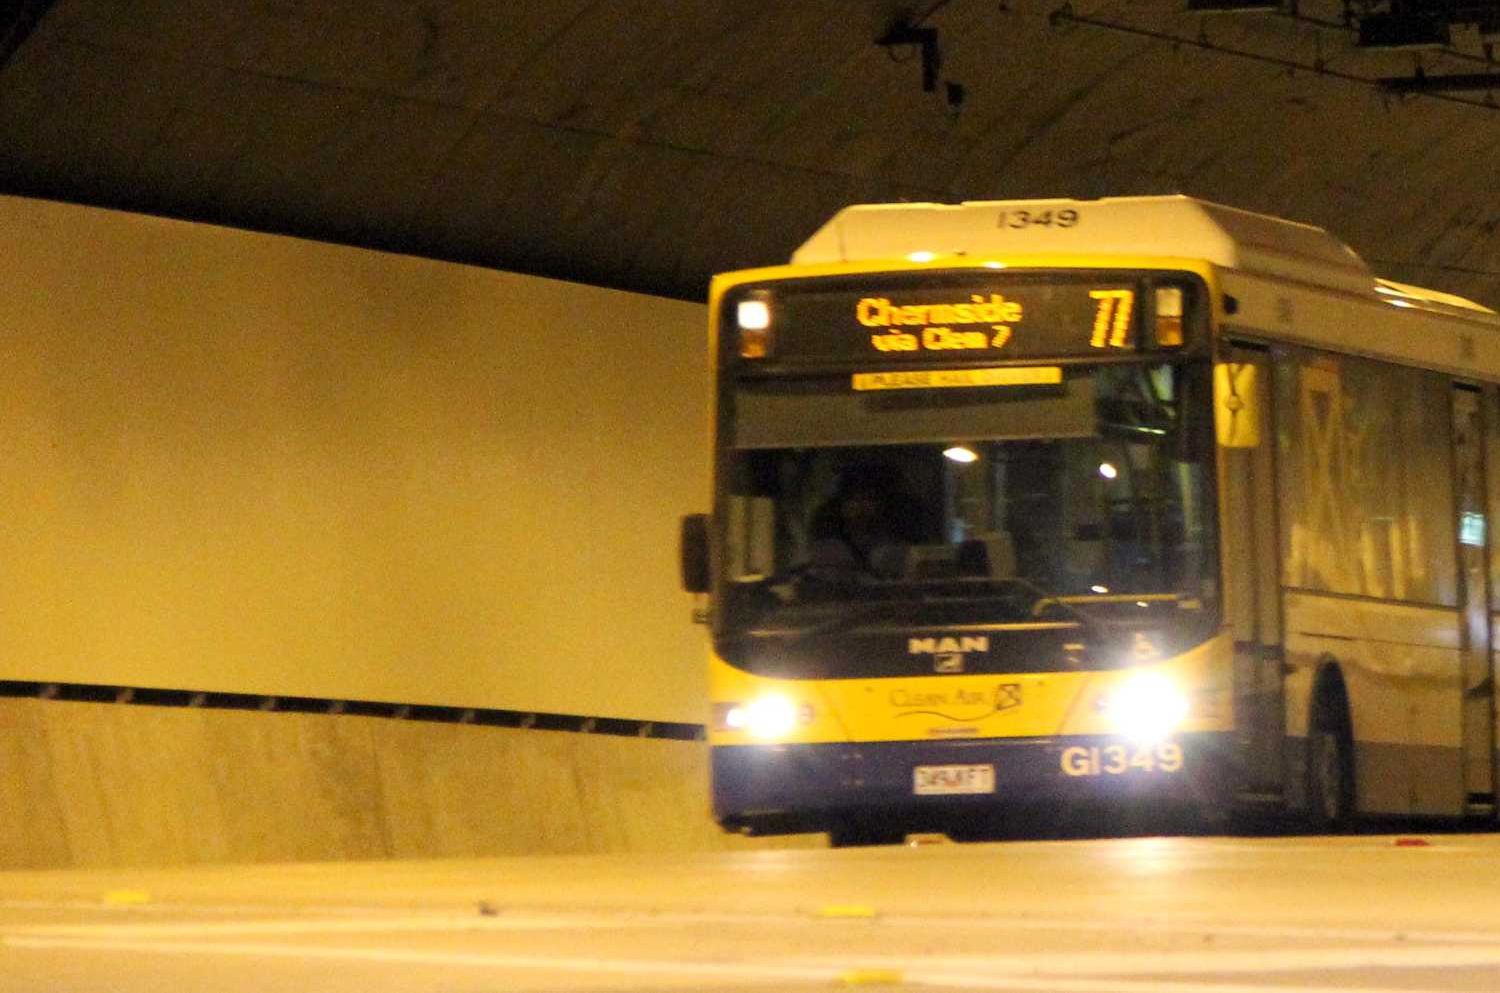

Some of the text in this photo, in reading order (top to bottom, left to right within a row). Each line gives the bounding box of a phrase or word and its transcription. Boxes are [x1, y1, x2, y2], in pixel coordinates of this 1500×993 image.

[996, 209, 1078, 229] 1349
[857, 294, 1023, 327] Chermside
[1089, 290, 1134, 348] 77
[871, 328, 918, 351] via
[991, 325, 1012, 348] 7
[908, 636, 990, 654] MAN
